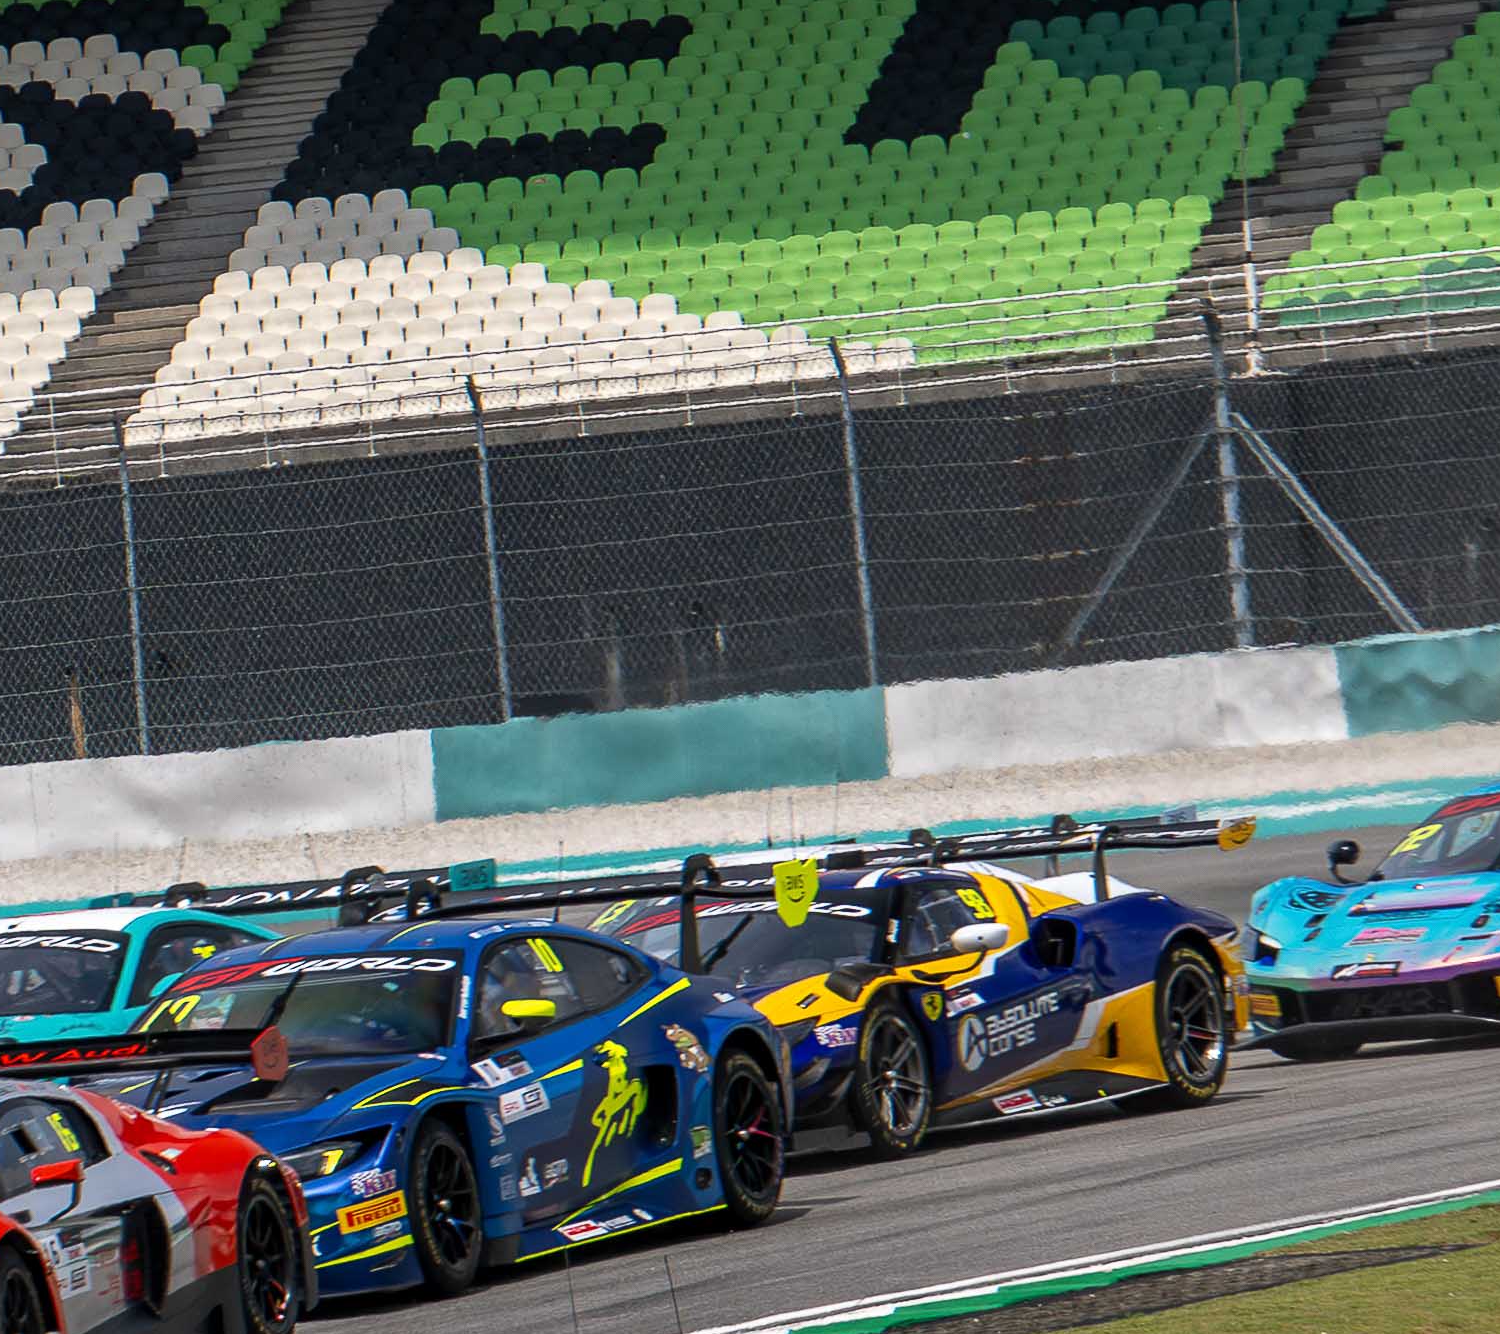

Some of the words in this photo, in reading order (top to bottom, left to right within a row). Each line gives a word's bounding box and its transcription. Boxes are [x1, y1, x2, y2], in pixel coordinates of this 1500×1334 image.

[260, 956, 456, 978] WORLD
[53, 1043, 149, 1064] Audi
[344, 1196, 404, 1232] PIRELLI
